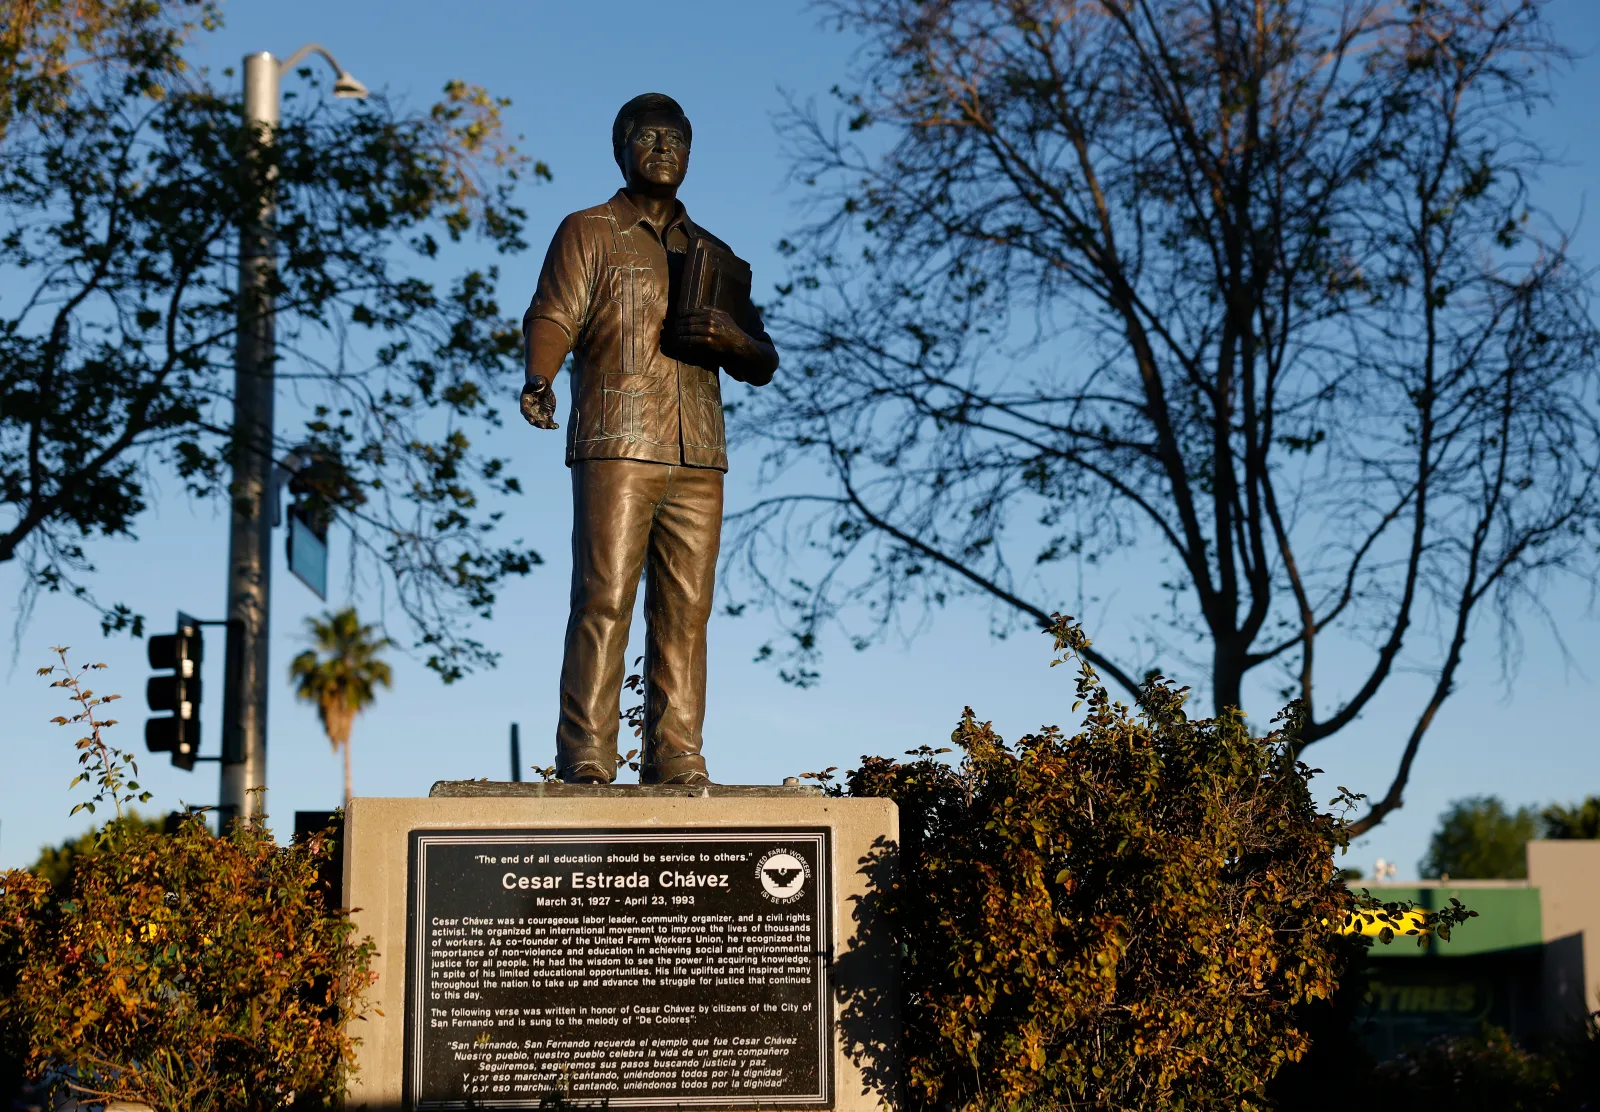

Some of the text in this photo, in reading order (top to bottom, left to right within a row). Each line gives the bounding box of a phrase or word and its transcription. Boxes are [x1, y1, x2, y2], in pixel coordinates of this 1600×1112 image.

[523, 855, 533, 863] of
[538, 855, 549, 863] all
[607, 854, 639, 862] should
[643, 854, 655, 862] be
[660, 854, 695, 862] service
[713, 853, 752, 861] others."
[755, 848, 811, 879] UNITED FARM WORKERS
[502, 871, 728, 889] Cesar Estrada Chávez
[536, 895, 694, 906] March 31, 1927 April 23, 1993
[432, 917, 458, 926] Cesar
[462, 916, 493, 925] Chávez
[527, 917, 578, 926] courageous
[582, 915, 604, 924] labor
[608, 915, 637, 925] leader,
[641, 914, 688, 925] community
[691, 914, 734, 924] organizer,
[738, 913, 753, 922] and
[766, 913, 782, 922] civil
[786, 913, 810, 924] rights
[431, 923, 810, 937] activist. He organized international movement to improve the lives of thousands
[431, 933, 810, 947] of workers. As co-founder of the United Farm Workers Union, he recognized the
[431, 944, 810, 959] importance of non-violence and education in achieving social and environmental
[431, 959, 461, 970] justice
[465, 958, 478, 967] for
[482, 958, 492, 967] all
[496, 958, 528, 969] people.
[533, 958, 544, 966] He
[548, 957, 565, 966] had
[569, 957, 582, 966] the
[587, 957, 620, 966] wisdom
[624, 956, 633, 965] to
[657, 956, 671, 965] the
[675, 957, 702, 966] power
[706, 955, 713, 964] in
[717, 955, 757, 966] acquiring
[761, 954, 810, 965] knowledge,
[443, 965, 810, 980] spite of his limited educational opportunities. His life uplifted and inspired many
[431, 975, 810, 991] throughout the nation to take up and advance the struggle for justice that continues
[431, 990, 481, 1001] to this day.
[431, 1008, 447, 1017] The
[451, 1007, 490, 1018] following
[545, 1006, 575, 1015] written
[579, 1006, 587, 1014] in
[591, 1005, 616, 1014] honor
[620, 1005, 629, 1014] of
[633, 1005, 659, 1014] Cesar
[663, 1004, 694, 1013] Chávez
[698, 1004, 709, 1015] by
[712, 1003, 746, 1012] citizens
[750, 1003, 759, 1012] of
[763, 1003, 777, 1012] the
[781, 1002, 798, 1013] City
[802, 1002, 811, 1011] of
[430, 1018, 448, 1027] San
[452, 1018, 493, 1027] Fernando
[498, 1017, 514, 1026] and
[530, 1019, 551, 1028] sung
[555, 1016, 564, 1025] to
[568, 1016, 582, 1025] the
[586, 1016, 618, 1027] melody
[622, 1015, 631, 1024] of
[635, 1015, 651, 1024] "De
[446, 1036, 797, 1050] "San San Fernando recuerda ejemplo que fue Cesar Chávez
